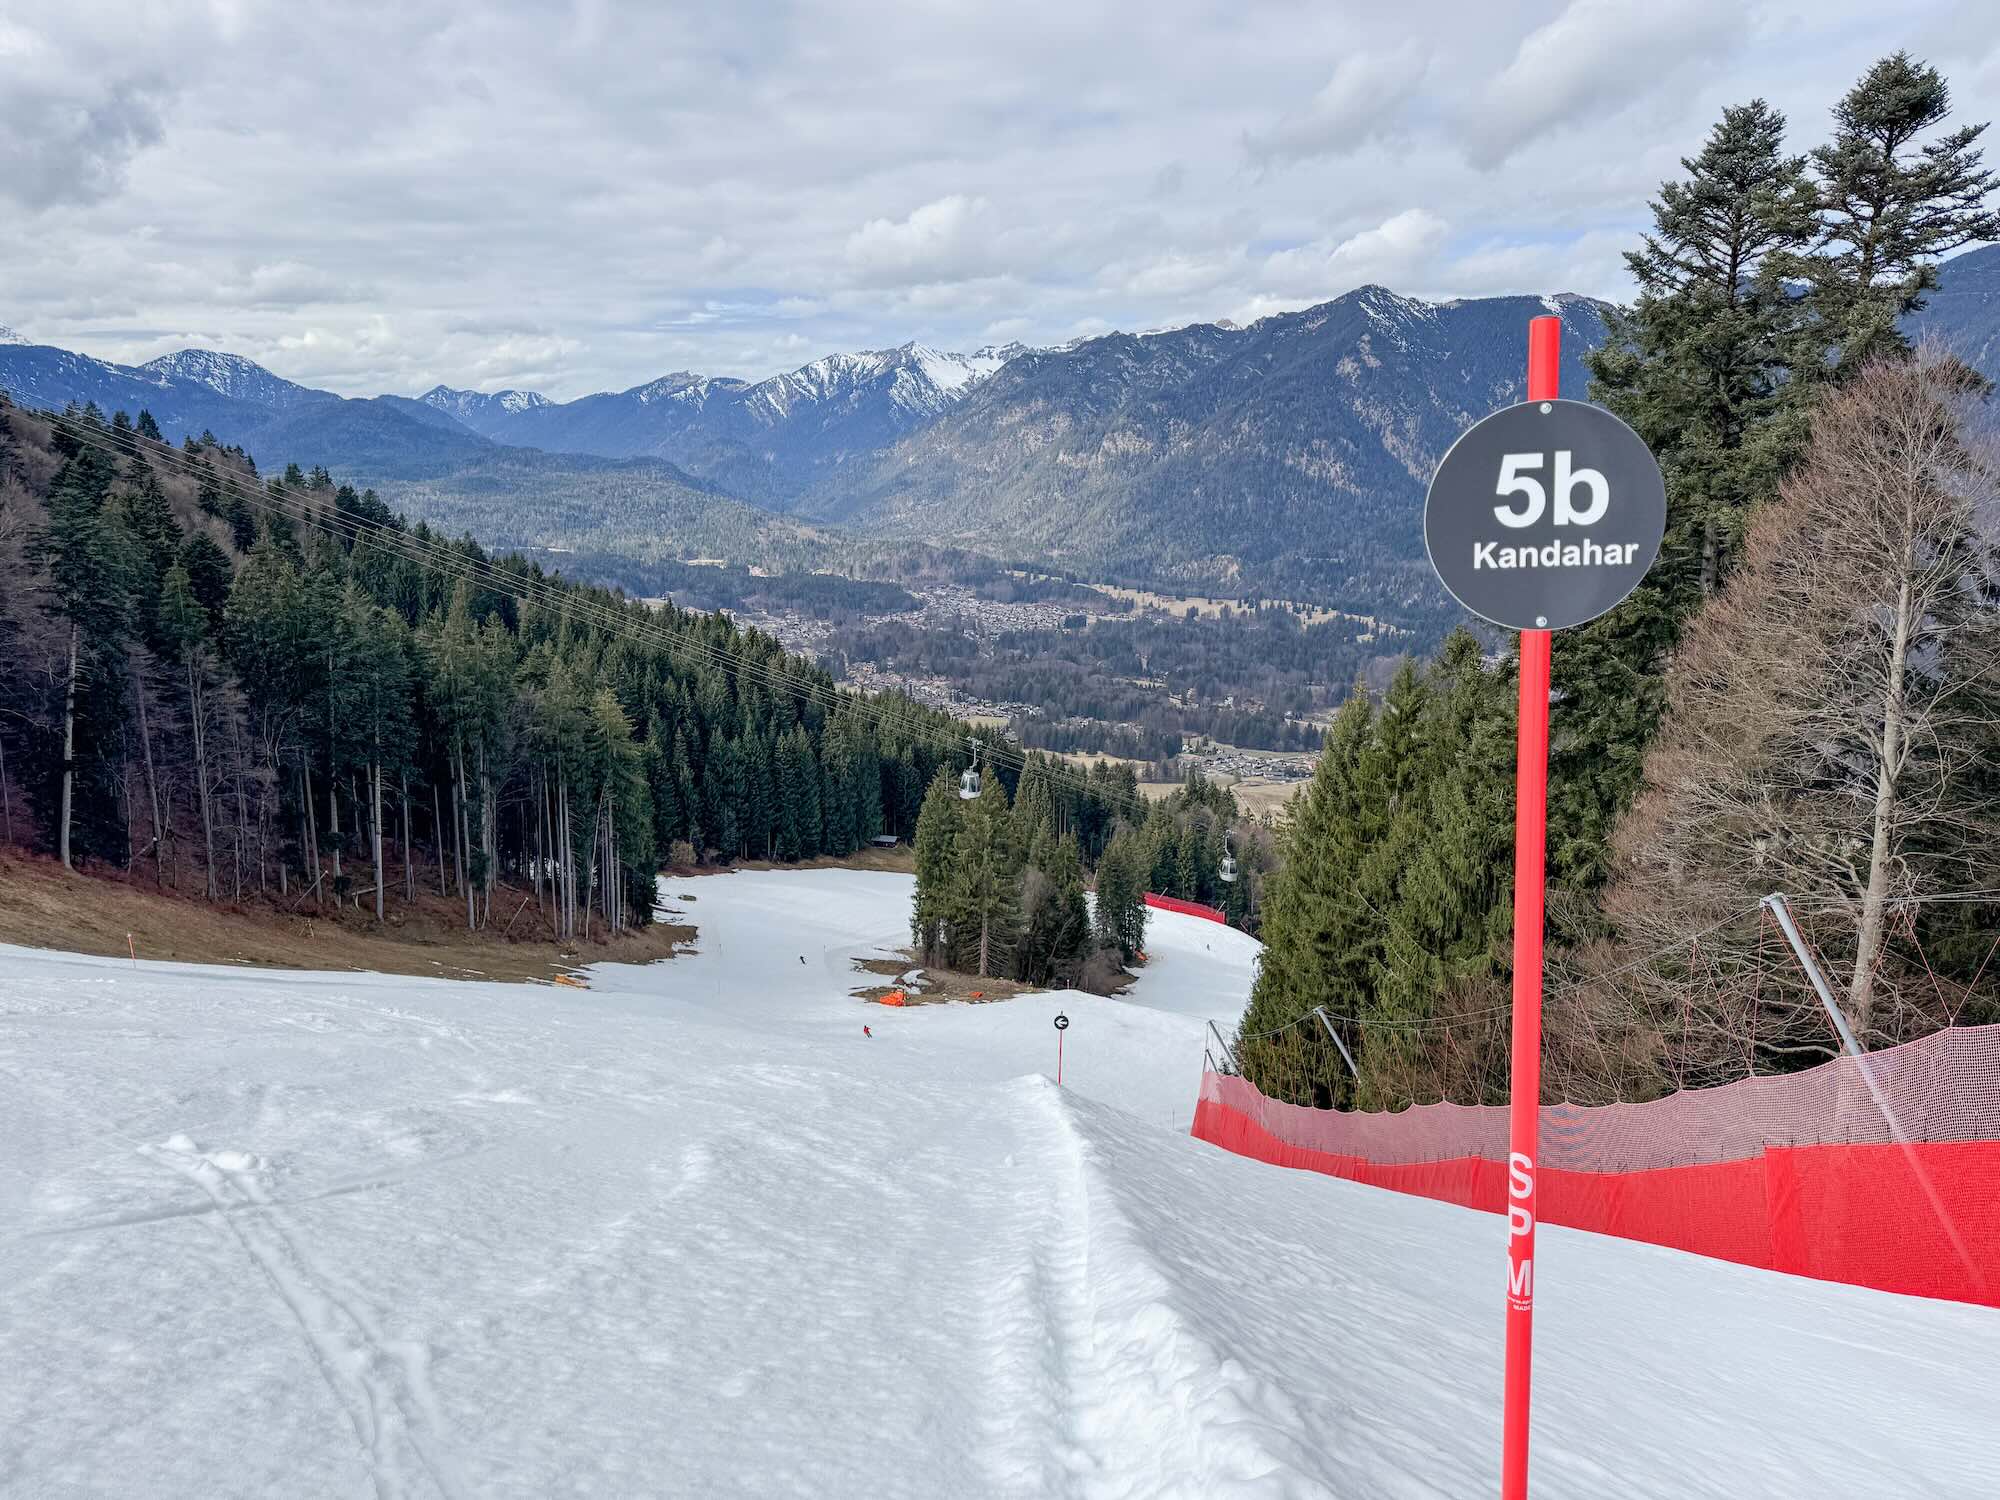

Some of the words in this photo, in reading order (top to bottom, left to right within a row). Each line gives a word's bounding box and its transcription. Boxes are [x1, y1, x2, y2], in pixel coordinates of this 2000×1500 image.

[1493, 450, 1610, 528] 5b
[1473, 539, 1639, 569] Kandahar
[1507, 1153, 1533, 1296] SPM
